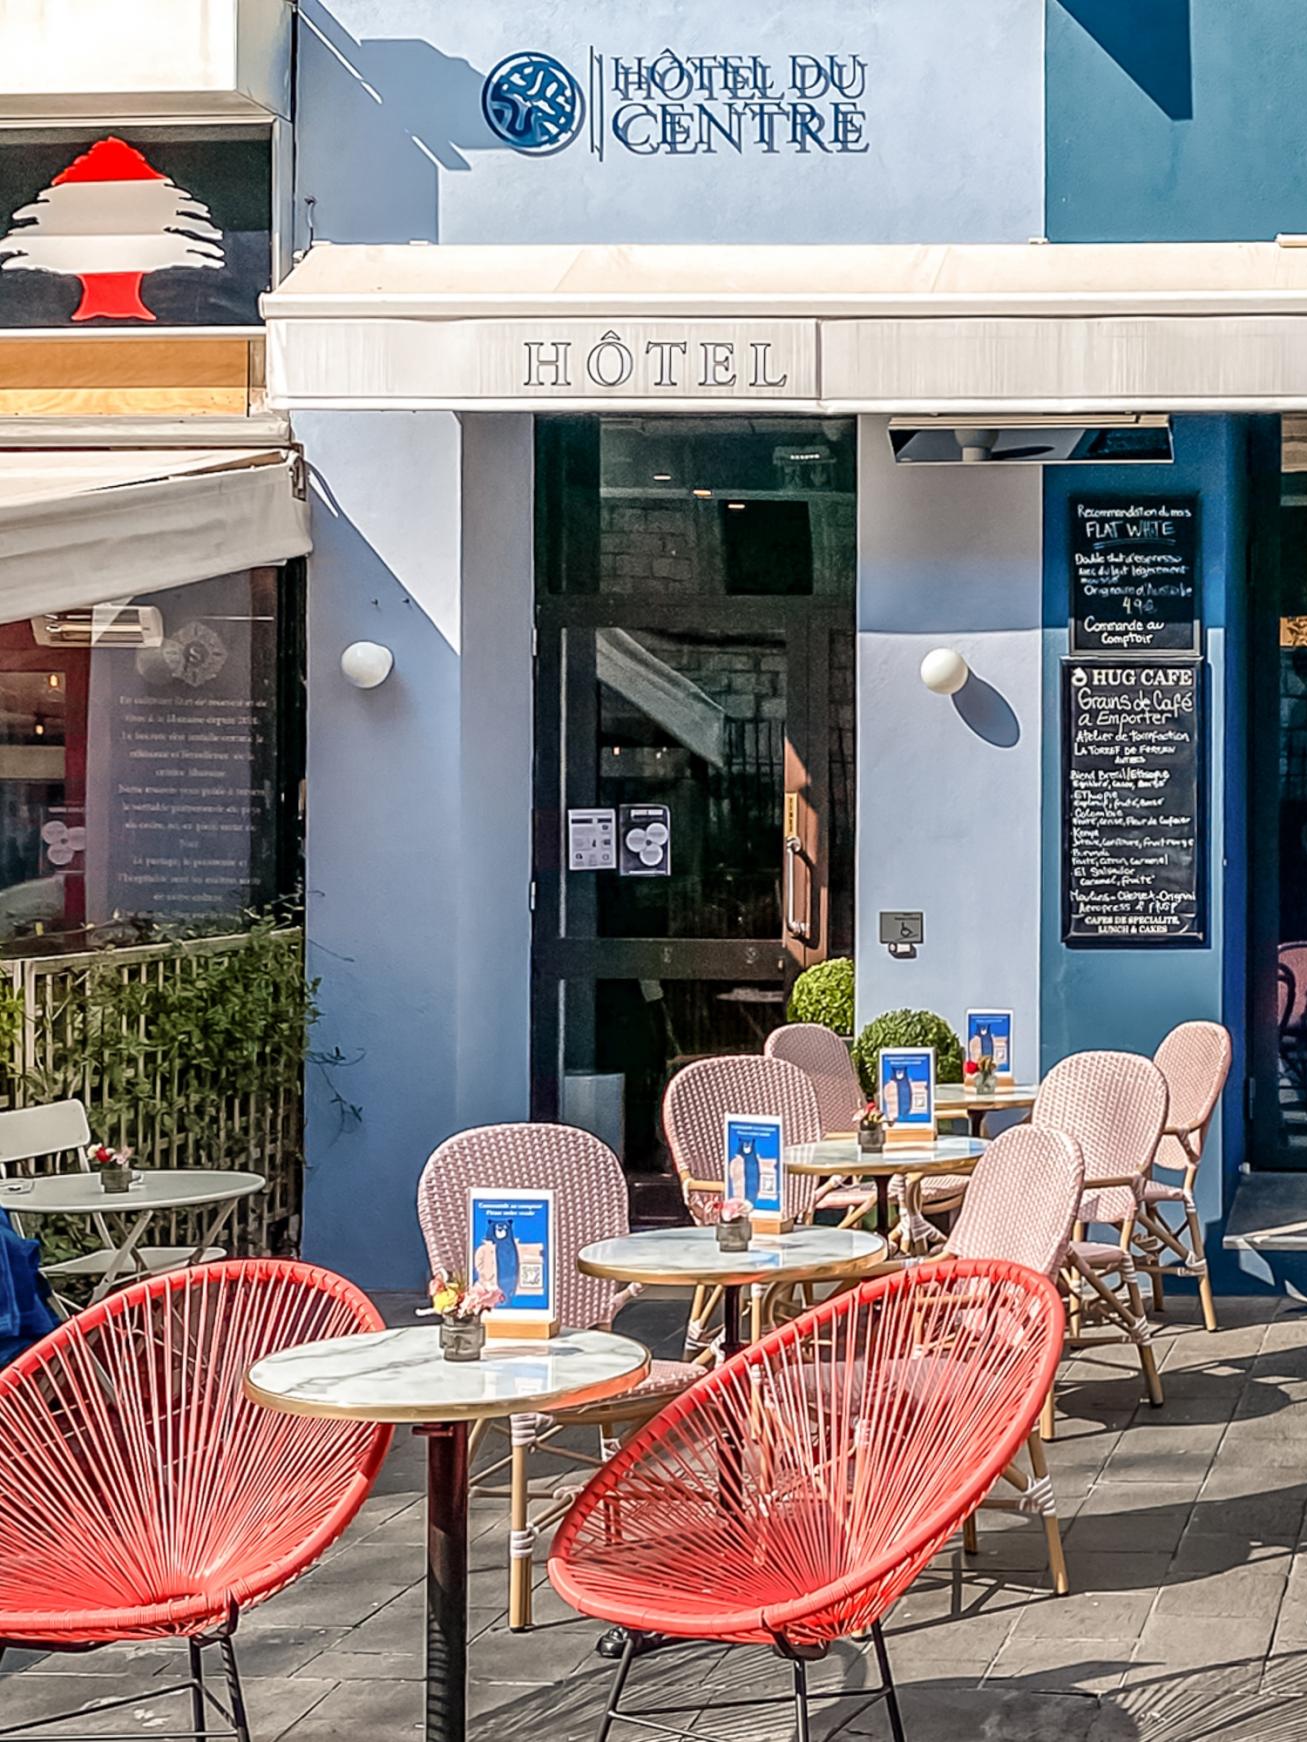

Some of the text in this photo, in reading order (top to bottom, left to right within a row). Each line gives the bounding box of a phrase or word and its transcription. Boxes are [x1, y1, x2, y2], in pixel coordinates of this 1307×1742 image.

[611, 47, 860, 93] HÔTEL DU
[611, 101, 860, 147] CENTRE
[523, 329, 788, 388] HÔTEL
[1086, 520, 1176, 538] FLAT WHITE
[1084, 615, 1165, 633] Commande au
[1092, 669, 1193, 686] HUG CAFE
[1077, 687, 1193, 718] Grains de Café
[1096, 711, 1172, 733] Emporter
[1076, 730, 1114, 743] Atelier
[1115, 729, 1128, 741] de
[1098, 925, 1129, 934] LUNCH
[1139, 925, 1168, 934] CAKES
